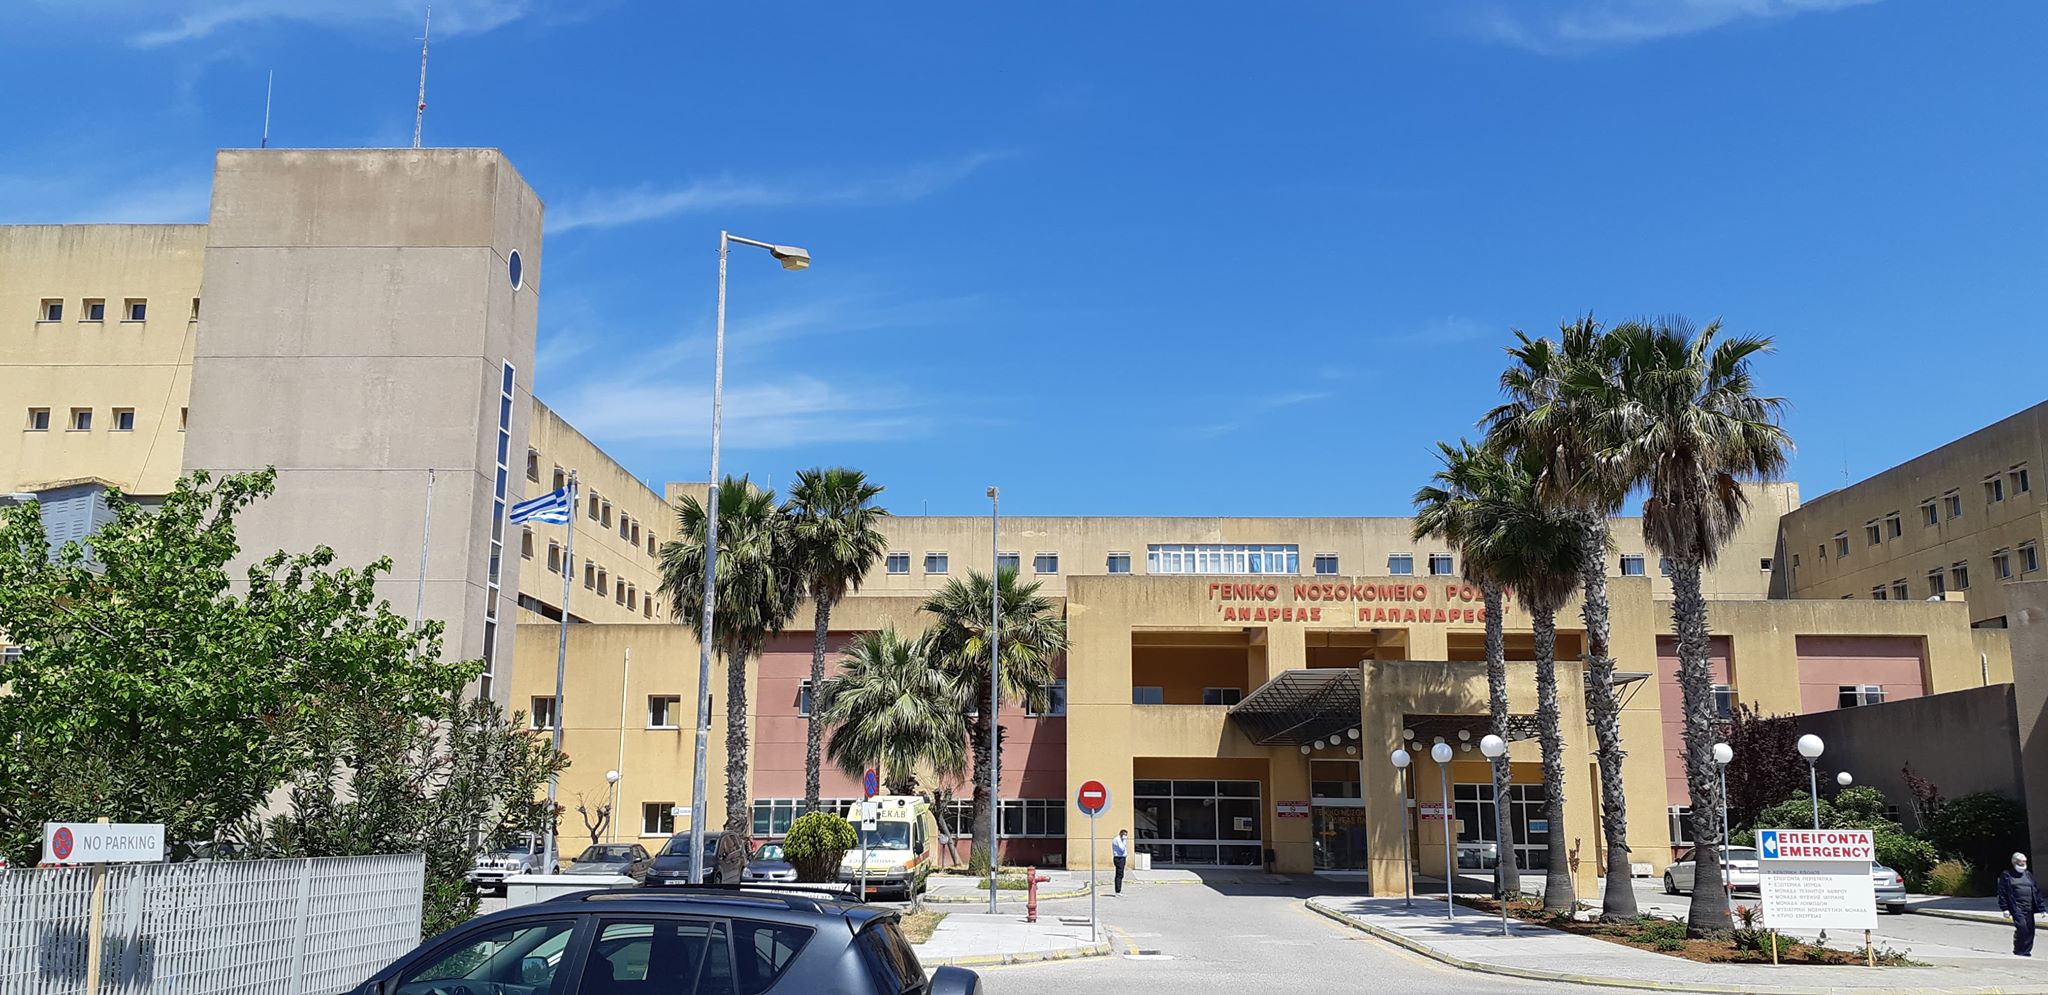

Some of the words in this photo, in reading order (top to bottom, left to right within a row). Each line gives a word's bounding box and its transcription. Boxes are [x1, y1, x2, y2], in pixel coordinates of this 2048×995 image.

[1209, 583, 1279, 601] ΓΕΝΙΚΟ
[1294, 584, 1428, 602] ΝΟΣΟΚΟΜΕΙΟ
[83, 836, 101, 850] NO
[105, 835, 155, 850] PARKING
[1779, 833, 1869, 844] ΕΠΕΙΓΟΝΤΑ
[1780, 846, 1871, 857] EMERGENCY
